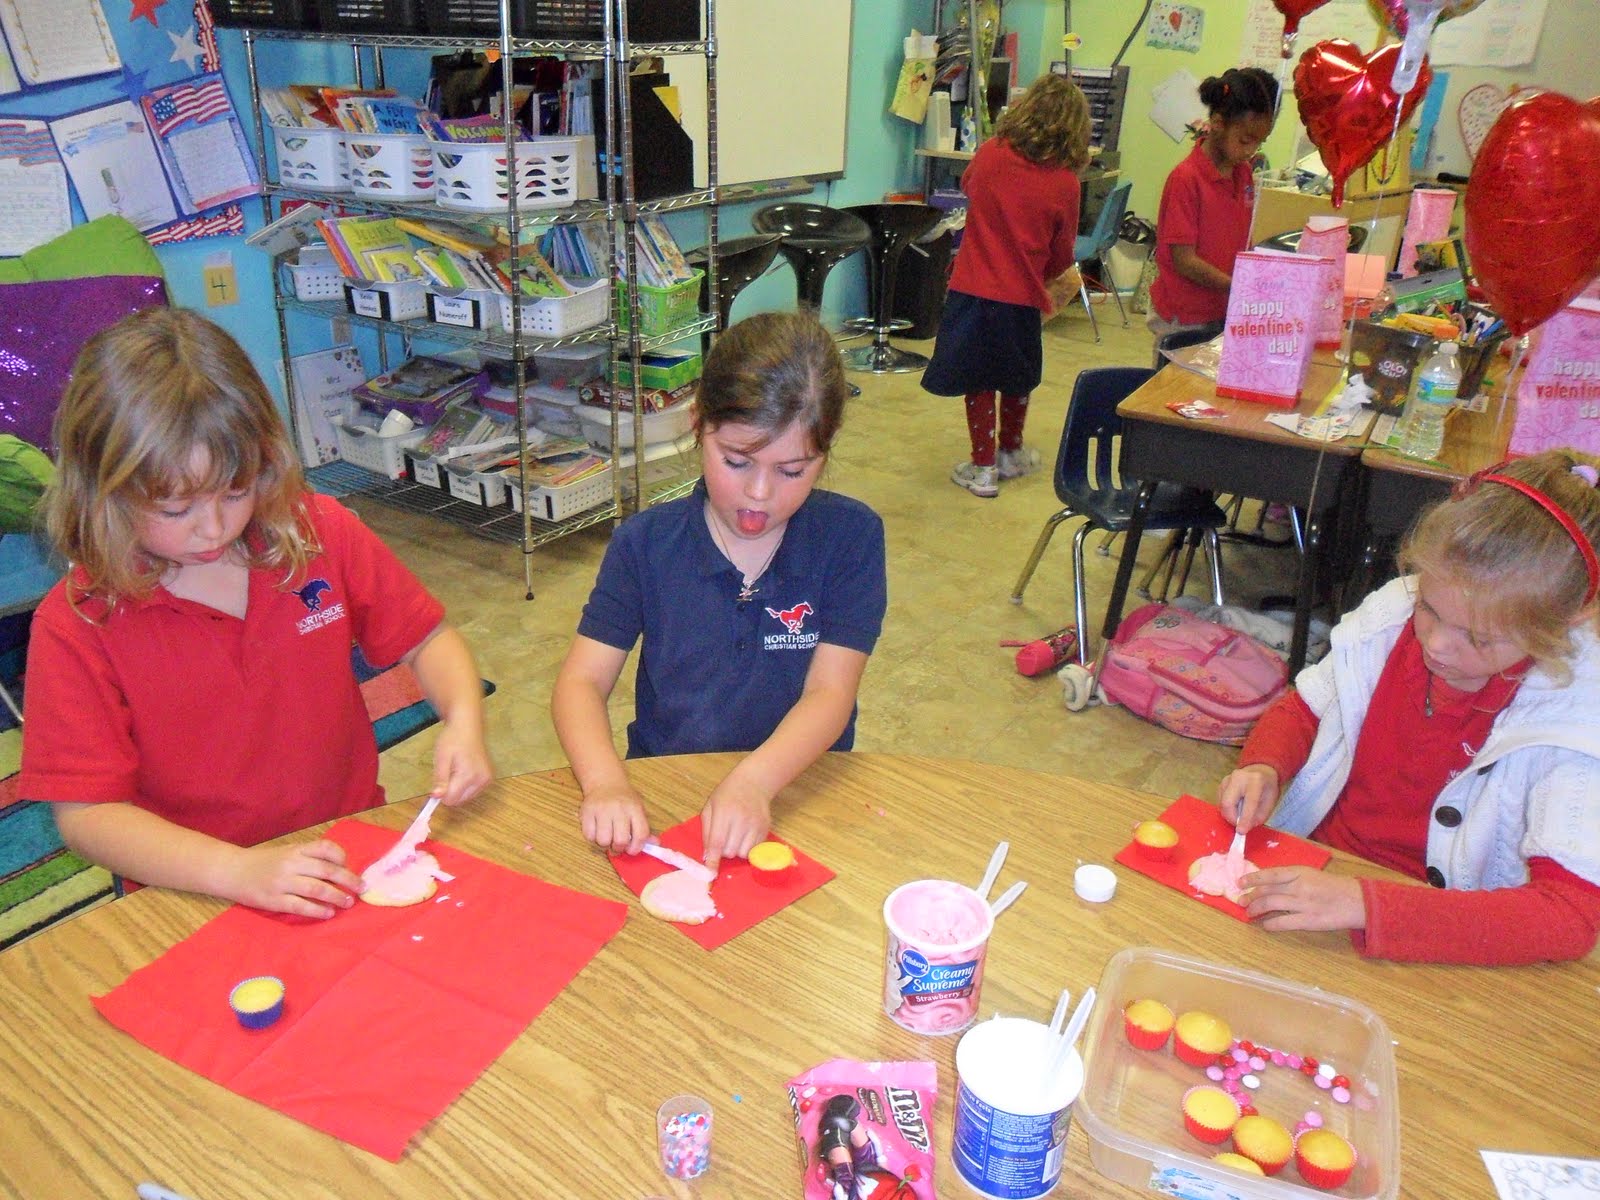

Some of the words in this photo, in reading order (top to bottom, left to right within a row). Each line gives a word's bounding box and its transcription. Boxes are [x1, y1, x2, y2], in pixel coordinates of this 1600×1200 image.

[1242, 299, 1284, 319] happy
[1230, 318, 1304, 337] valentine's
[1268, 337, 1298, 357] day!
[295, 603, 344, 629] NORTHSIDE
[764, 631, 820, 644] NORTHSIDE
[797, 642, 818, 650] SCHO
[902, 953, 929, 972] Pillsbury
[931, 965, 975, 981] Creamy
[912, 978, 966, 993] Supreme
[915, 991, 960, 1002] Strawberry
